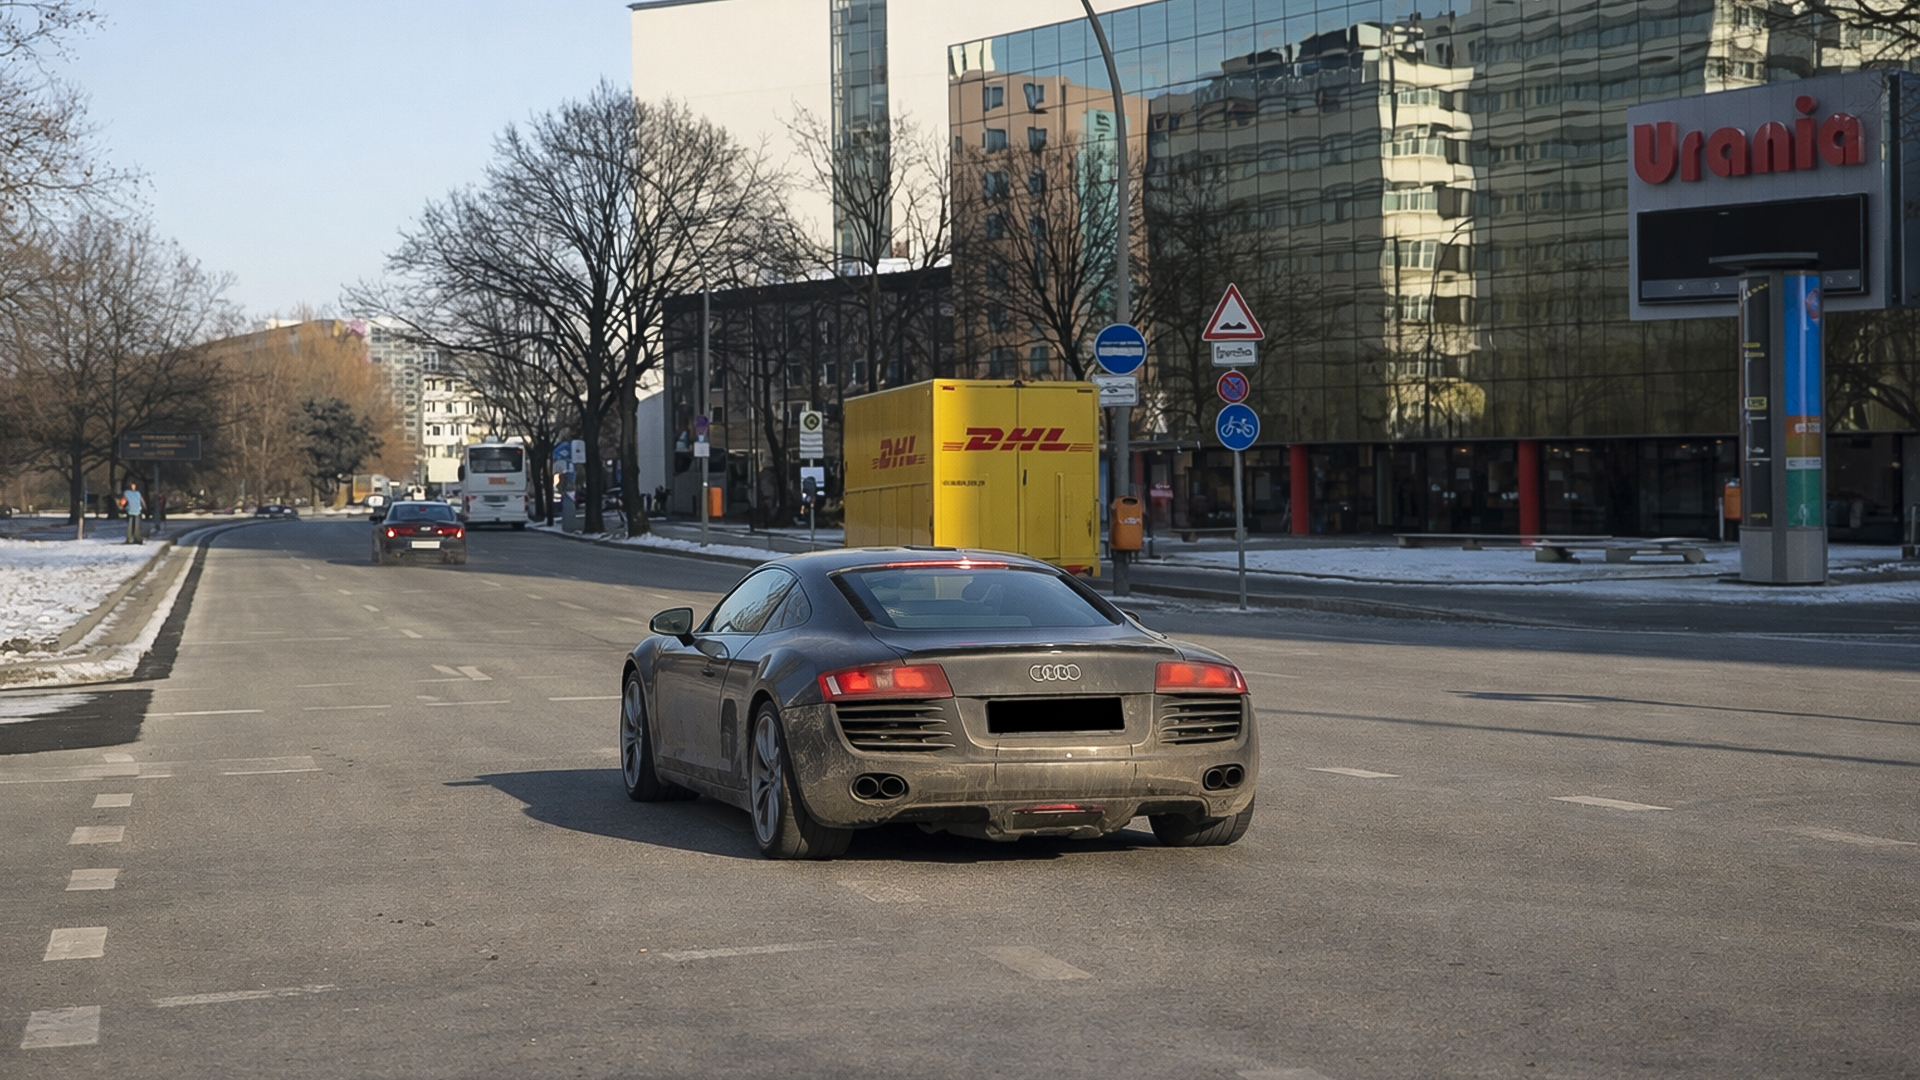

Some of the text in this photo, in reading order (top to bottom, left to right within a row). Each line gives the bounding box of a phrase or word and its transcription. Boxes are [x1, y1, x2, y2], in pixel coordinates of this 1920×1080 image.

[1633, 95, 1866, 184] Urania
[879, 435, 916, 470] DHL
[964, 427, 1071, 451] DHL
